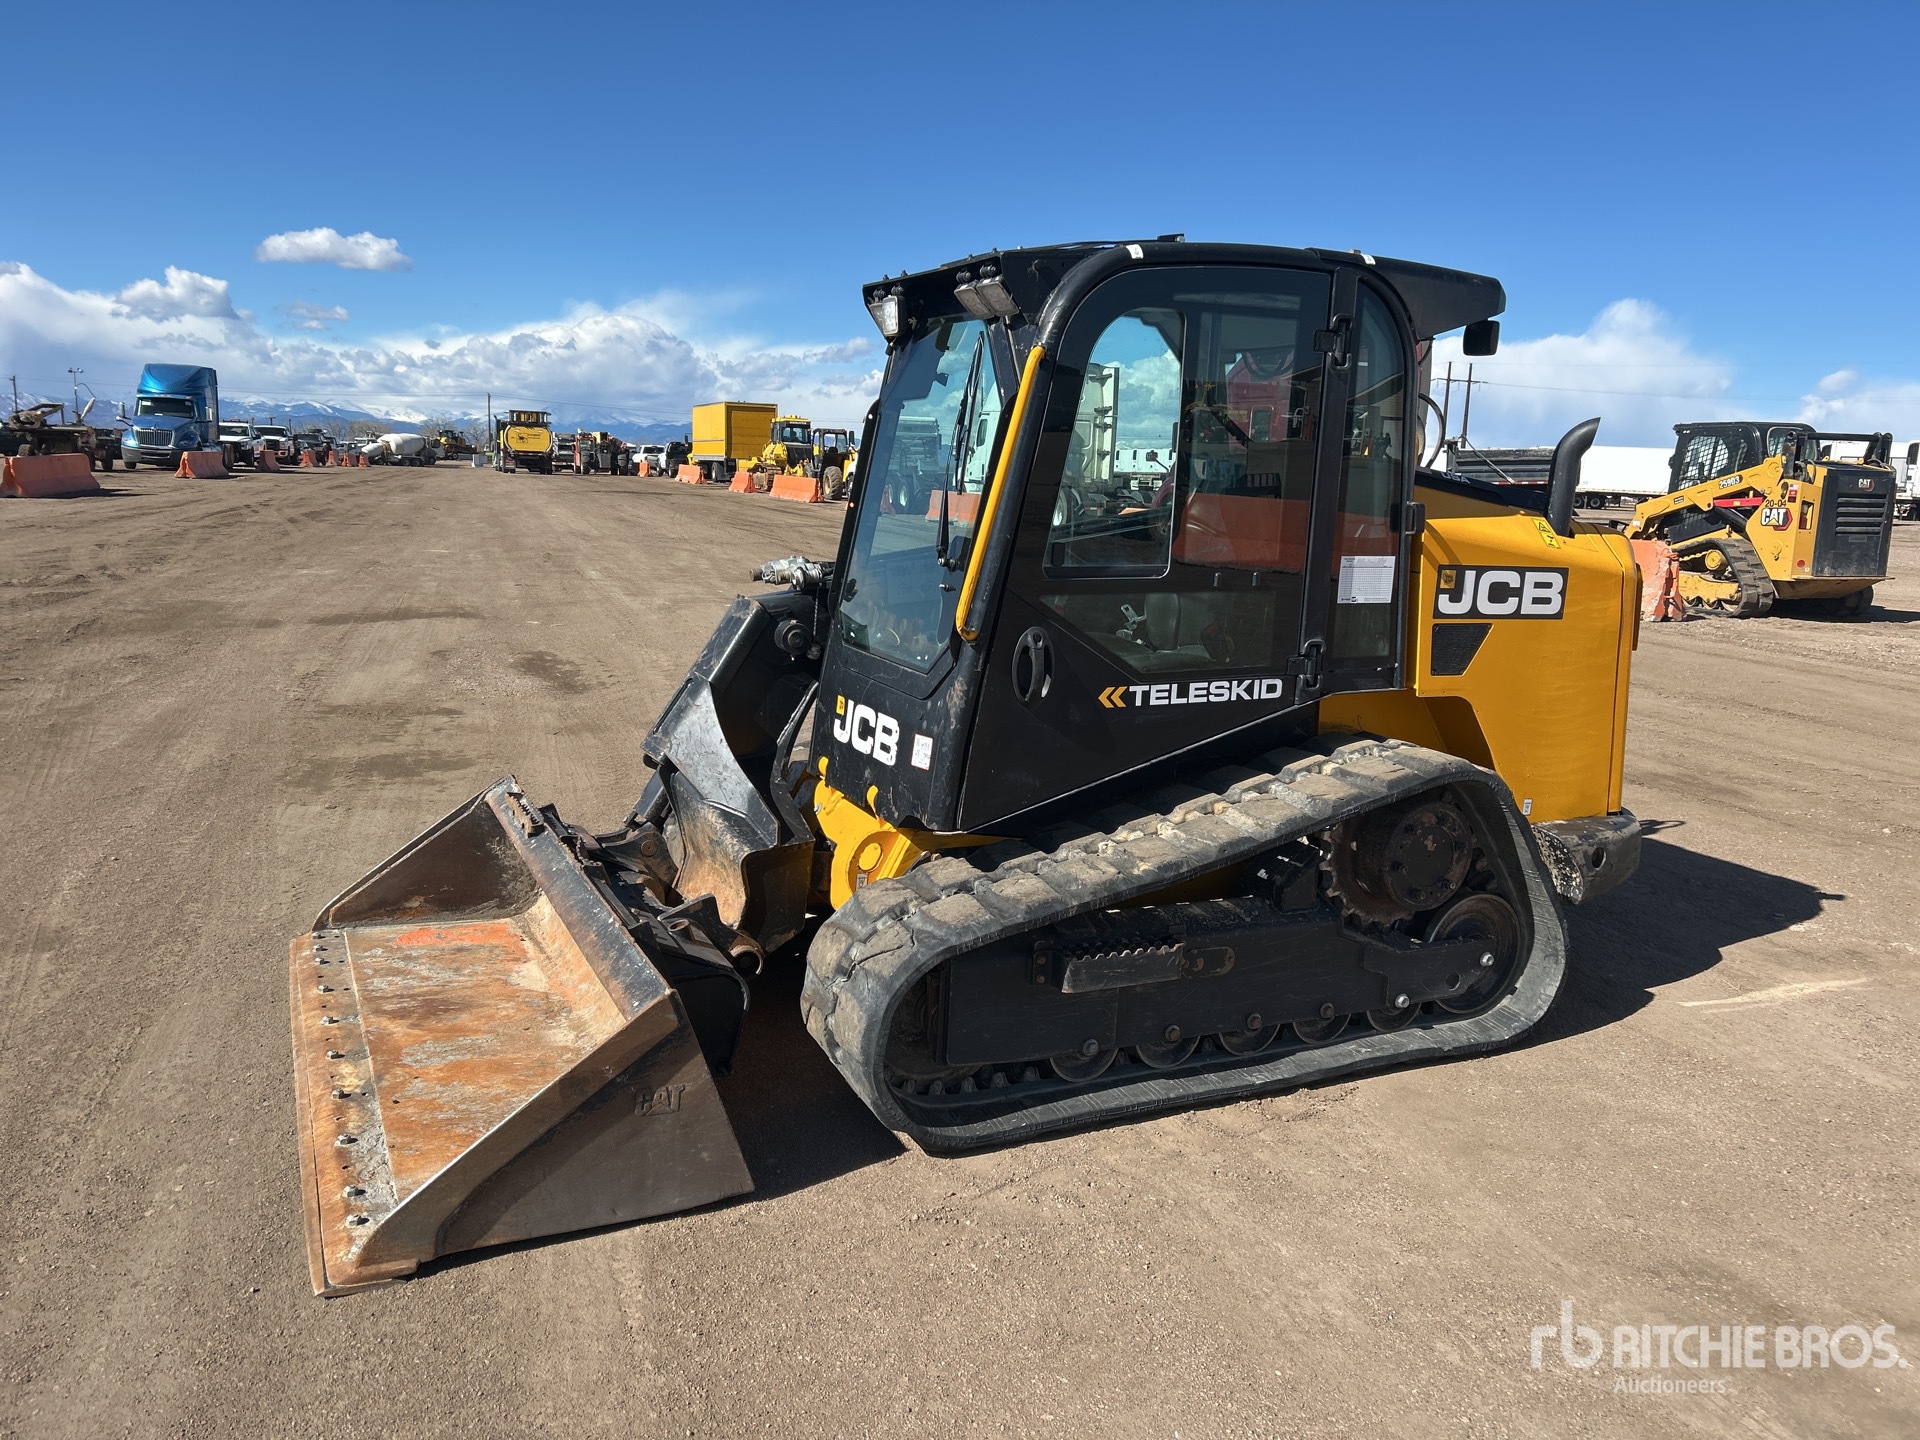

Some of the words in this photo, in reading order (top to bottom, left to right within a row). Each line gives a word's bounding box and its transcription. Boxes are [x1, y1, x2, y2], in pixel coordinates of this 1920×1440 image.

[1858, 478, 1871, 488] CAT
[1761, 508, 1787, 526] CAT
[1765, 499, 1787, 508] 20-04
[1438, 570, 1563, 615] JCB
[1129, 678, 1282, 706] TELESKID
[833, 699, 899, 766] JCB
[634, 1084, 686, 1116] CAT
